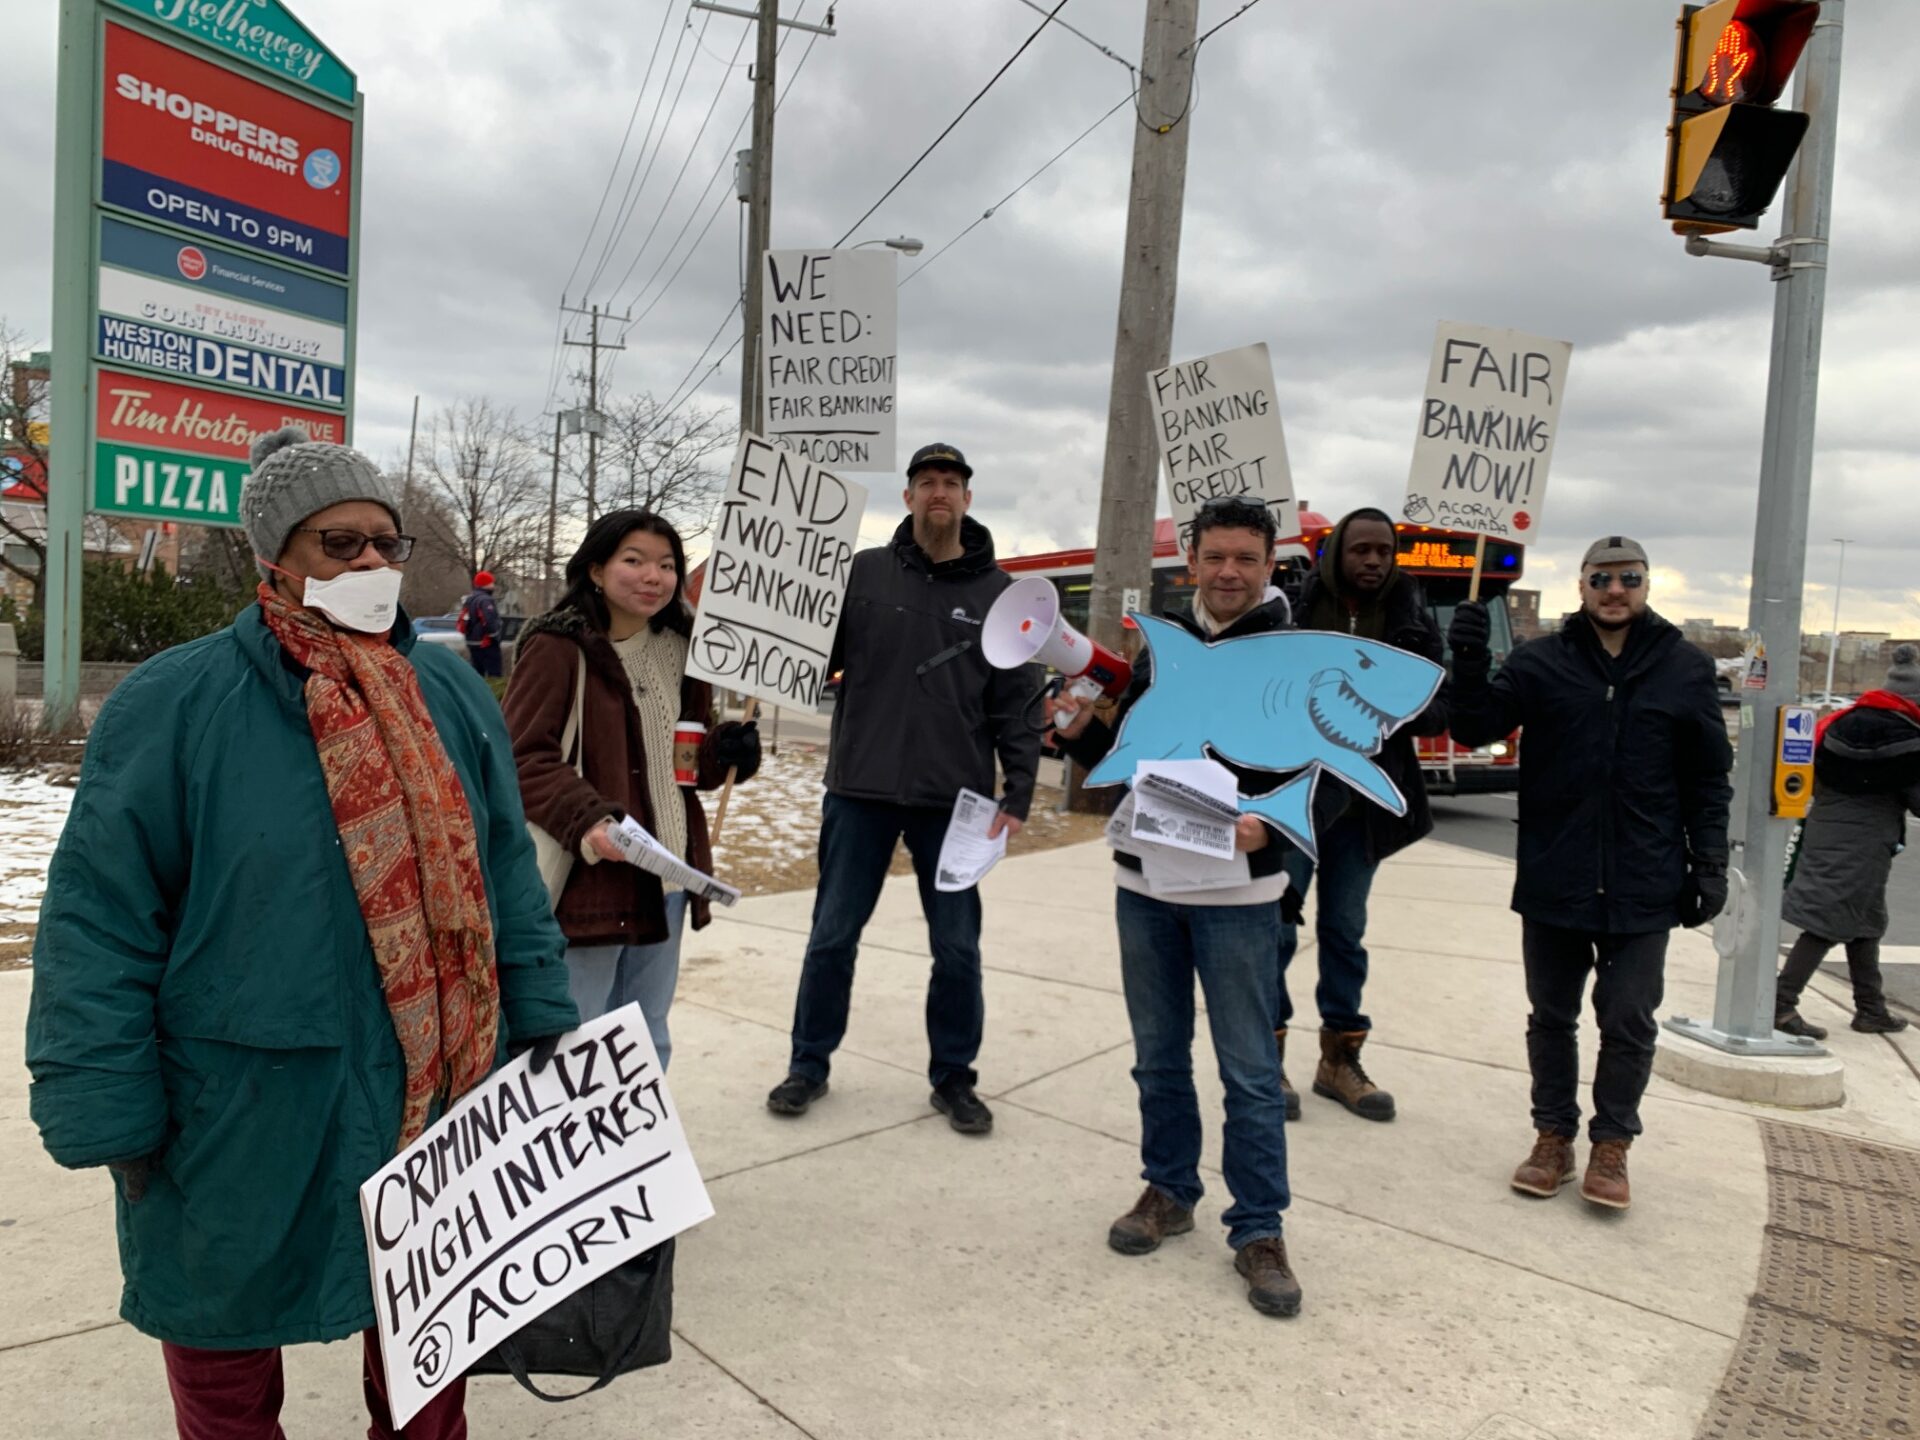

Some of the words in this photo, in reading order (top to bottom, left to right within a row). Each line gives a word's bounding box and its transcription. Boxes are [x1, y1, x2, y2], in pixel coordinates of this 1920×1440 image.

[115, 73, 299, 160] SHOPPERS
[191, 127, 245, 158] DRUG
[247, 147, 298, 176] MART
[147, 188, 220, 227] OPEN
[225, 212, 260, 238] TO
[267, 225, 313, 256] 9PM
[211, 265, 251, 284] Financial
[251, 275, 286, 293] Services
[768, 254, 832, 303] WE
[104, 318, 193, 354] WESTON
[140, 301, 207, 331] COIN
[213, 319, 322, 357] LAUNDRY
[770, 309, 872, 347] NEED:
[104, 338, 193, 373] HUMBER
[196, 339, 343, 404] DENTAL
[768, 355, 824, 388] FAIR
[828, 355, 897, 386] CREDIT
[1440, 338, 1552, 406] FAIR
[768, 396, 814, 422] FAIR
[819, 395, 893, 417] BANKING
[1153, 360, 1216, 407] FAIR
[110, 388, 168, 435] Tim
[1161, 389, 1269, 442] BANKING
[1422, 398, 1549, 453] BANKING
[798, 438, 870, 464] ACORN
[1167, 432, 1234, 478] FAIR
[114, 453, 229, 515] PIZZA
[737, 438, 849, 525] END
[1172, 456, 1267, 504] CREDIT
[1442, 451, 1535, 505] NOW!
[1438, 500, 1504, 520] ACORN
[1440, 516, 1510, 536] CANADA
[720, 501, 851, 589] TWO-TIER
[710, 550, 838, 629] BANKING
[741, 637, 827, 707] ACORN
[374, 1023, 649, 1251] CRIMINALIZE
[385, 1191, 493, 1336] HIGH
[493, 1077, 669, 1221] INTEREST
[467, 1184, 656, 1344] ACORN
